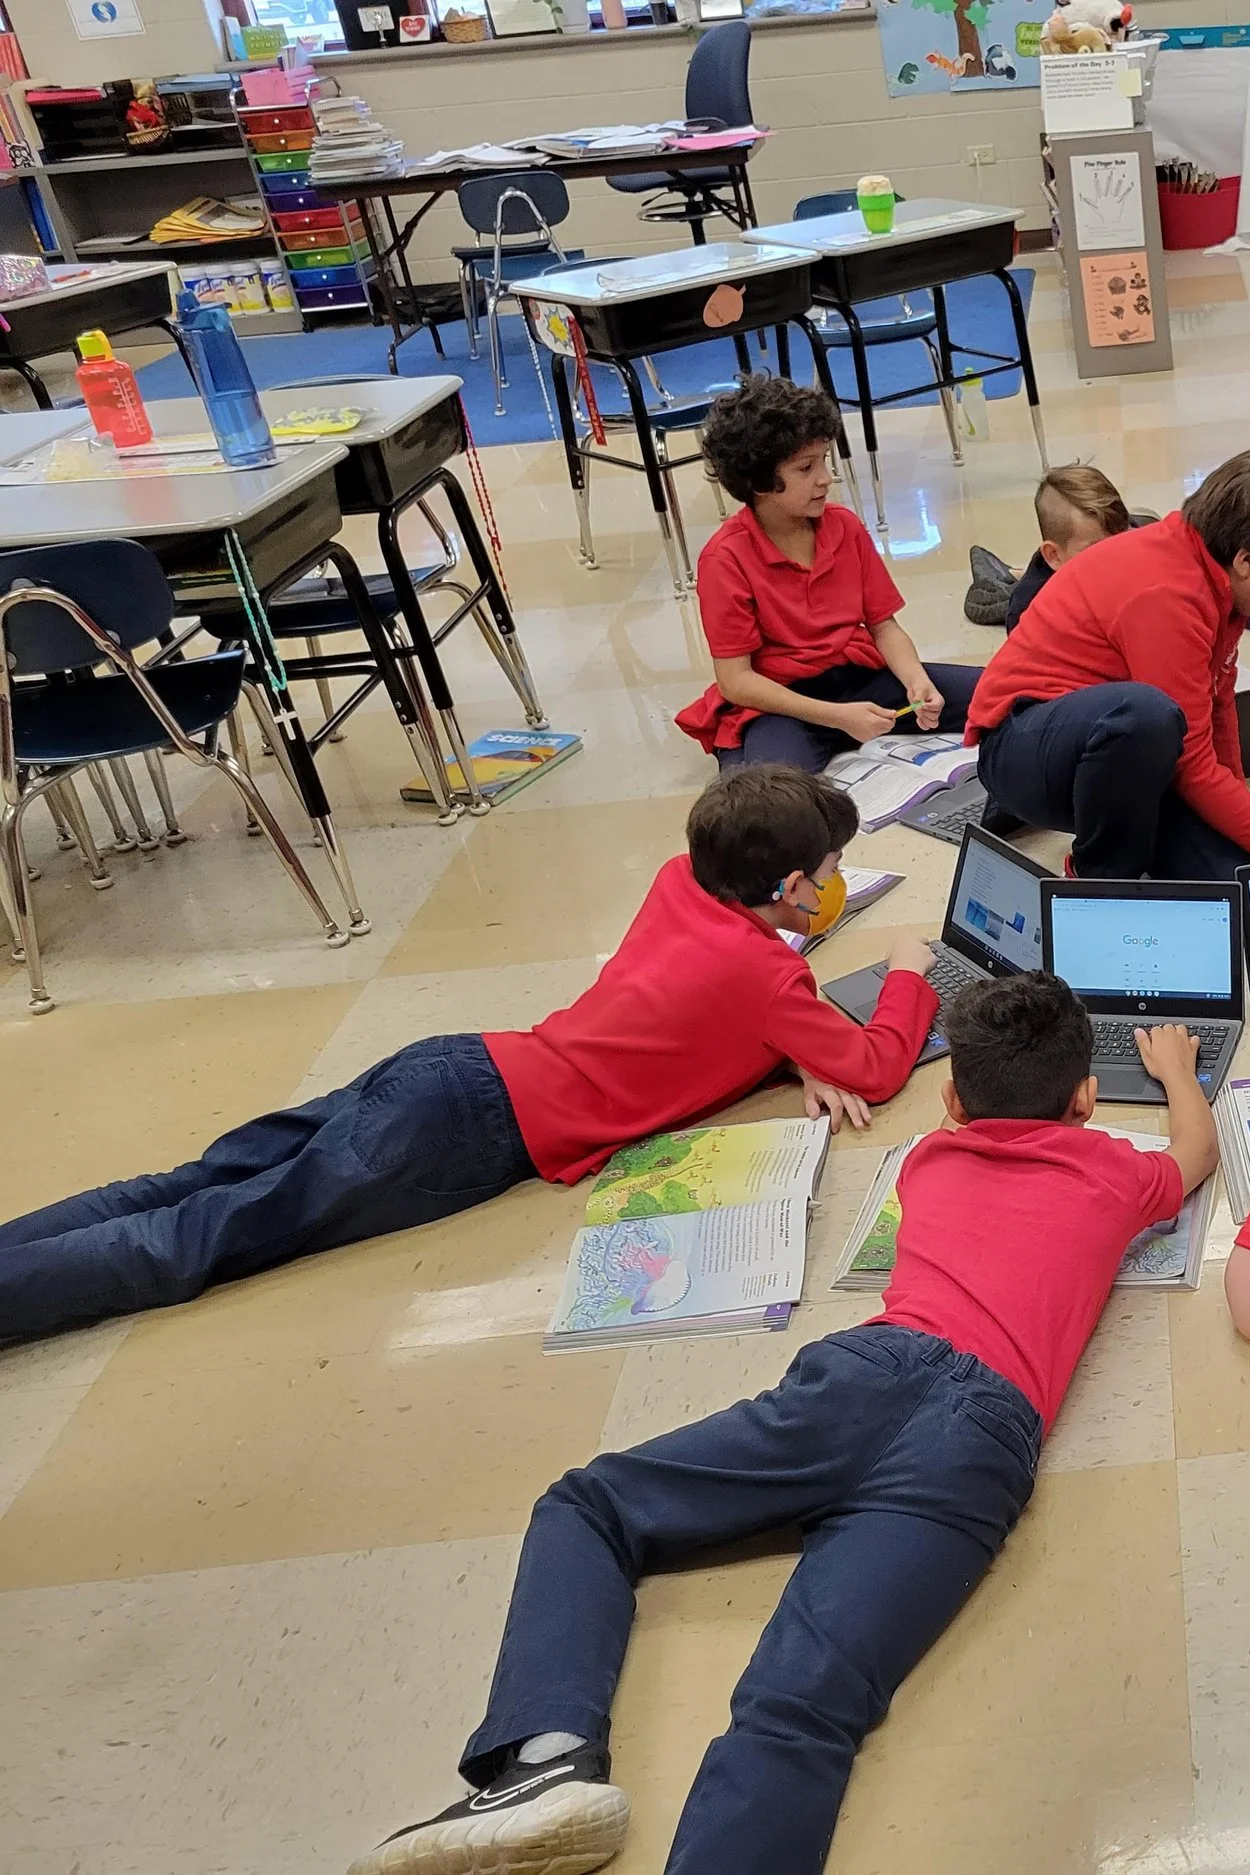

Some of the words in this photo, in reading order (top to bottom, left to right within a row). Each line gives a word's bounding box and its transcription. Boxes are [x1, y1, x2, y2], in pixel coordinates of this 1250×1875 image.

[1090, 61, 1102, 69] Day
[1096, 160, 1114, 169] Finger
[487, 733, 563, 747] SCIENCE
[1122, 934, 1159, 948] Google
